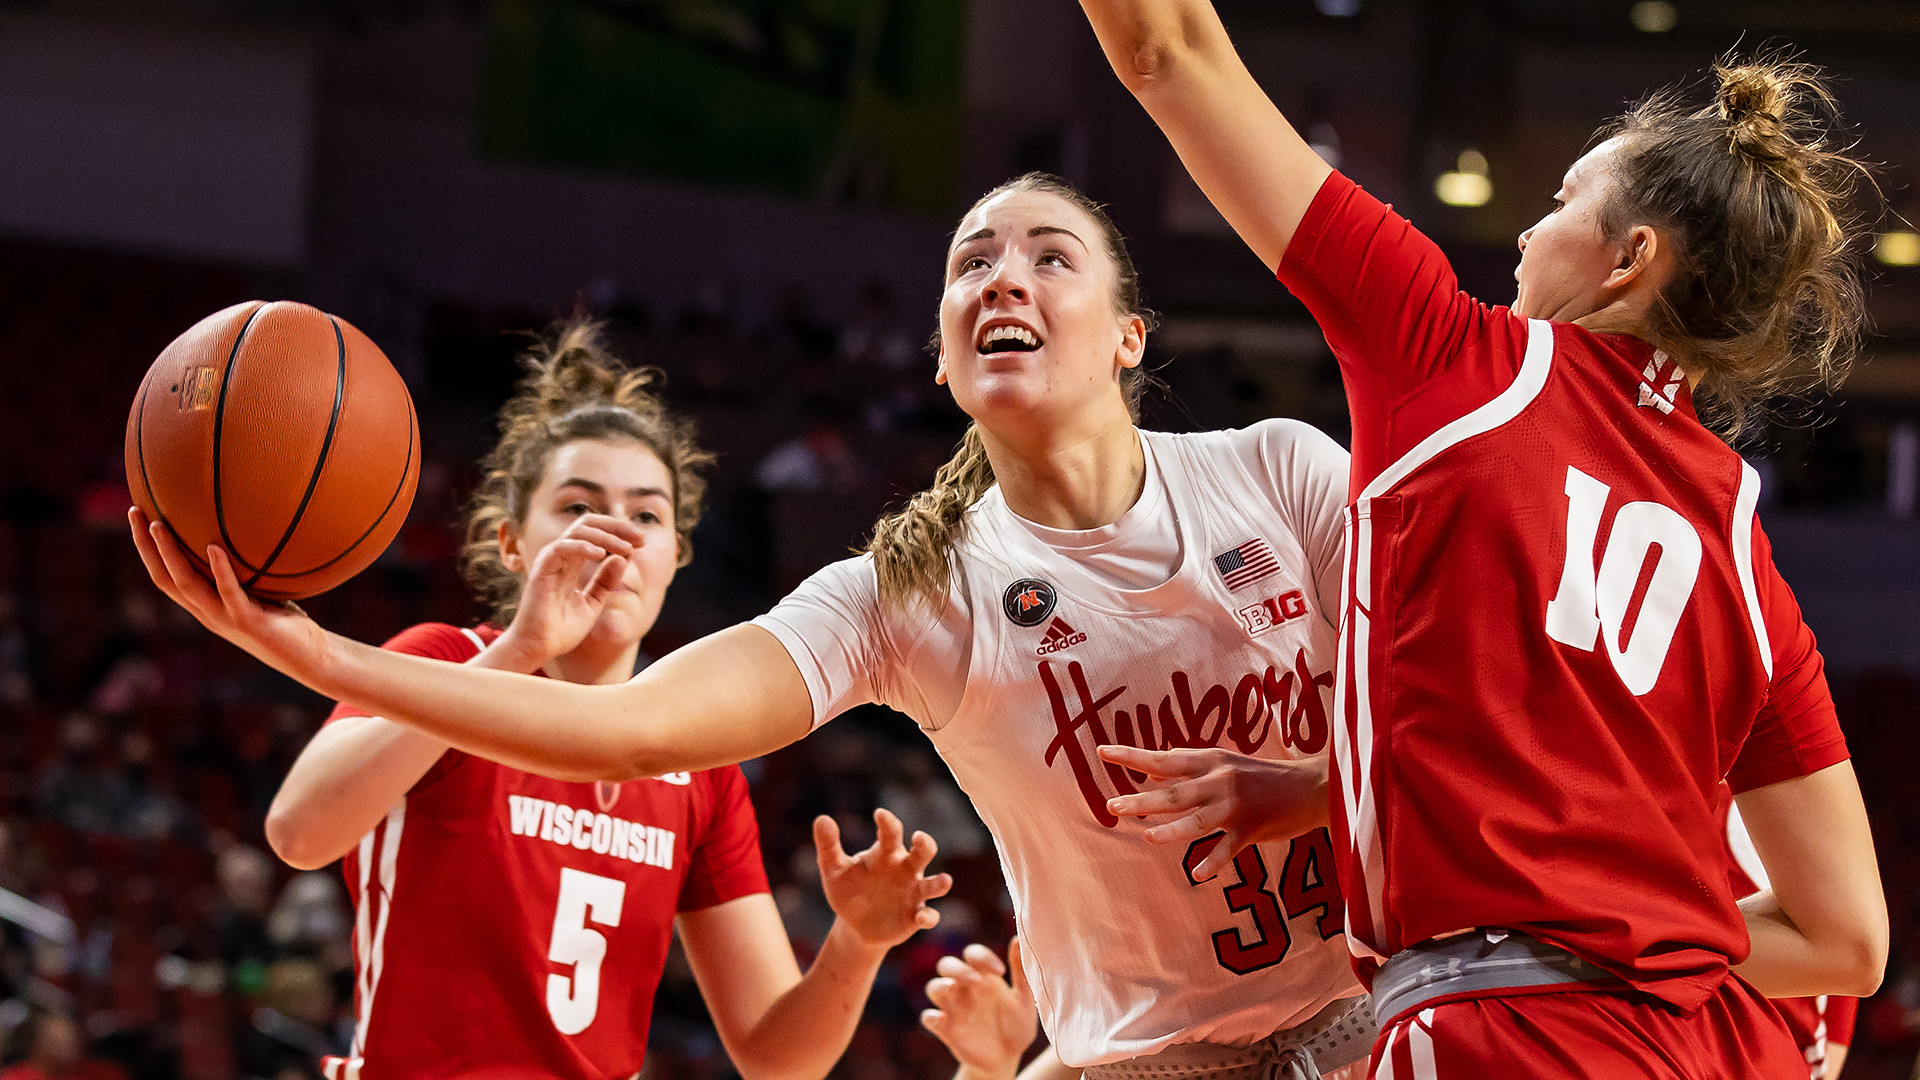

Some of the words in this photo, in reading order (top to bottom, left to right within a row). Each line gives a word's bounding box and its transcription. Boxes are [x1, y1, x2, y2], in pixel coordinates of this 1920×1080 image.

[1019, 590, 1041, 611] N
[1545, 465, 1702, 697] 10
[1036, 632, 1088, 655] adidas
[508, 794, 675, 870] WISCONSIN
[545, 867, 626, 1036] 5
[1182, 826, 1346, 976] 34
